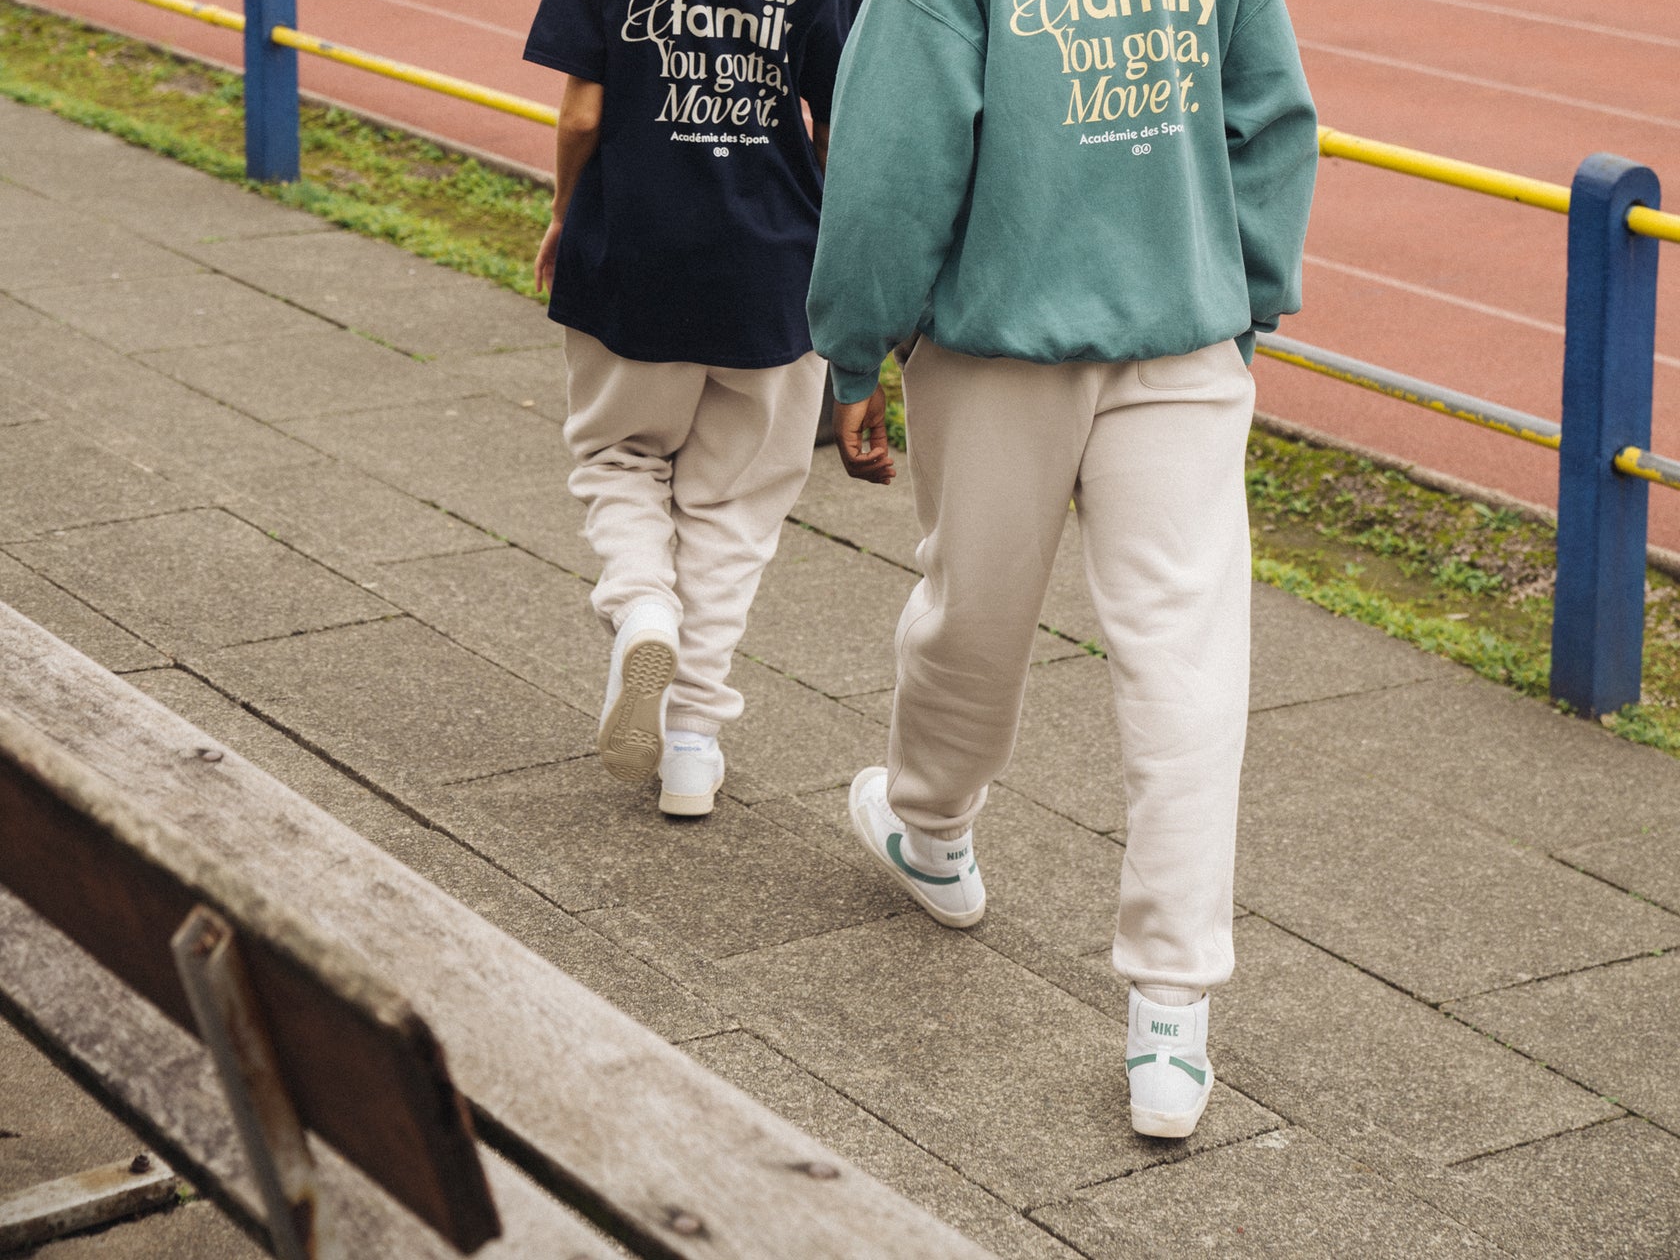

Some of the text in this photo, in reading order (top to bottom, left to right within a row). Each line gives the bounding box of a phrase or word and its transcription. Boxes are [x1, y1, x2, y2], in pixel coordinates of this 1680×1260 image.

[656, 39, 707, 80] You
[1053, 27, 1116, 74] You
[654, 83, 751, 126] Move
[1062, 75, 1171, 126] Move
[670, 131, 719, 143] Académie
[720, 132, 738, 143] des
[1080, 129, 1138, 145] Académie
[1140, 126, 1159, 138] des
[1150, 1020, 1179, 1037] NIKE
